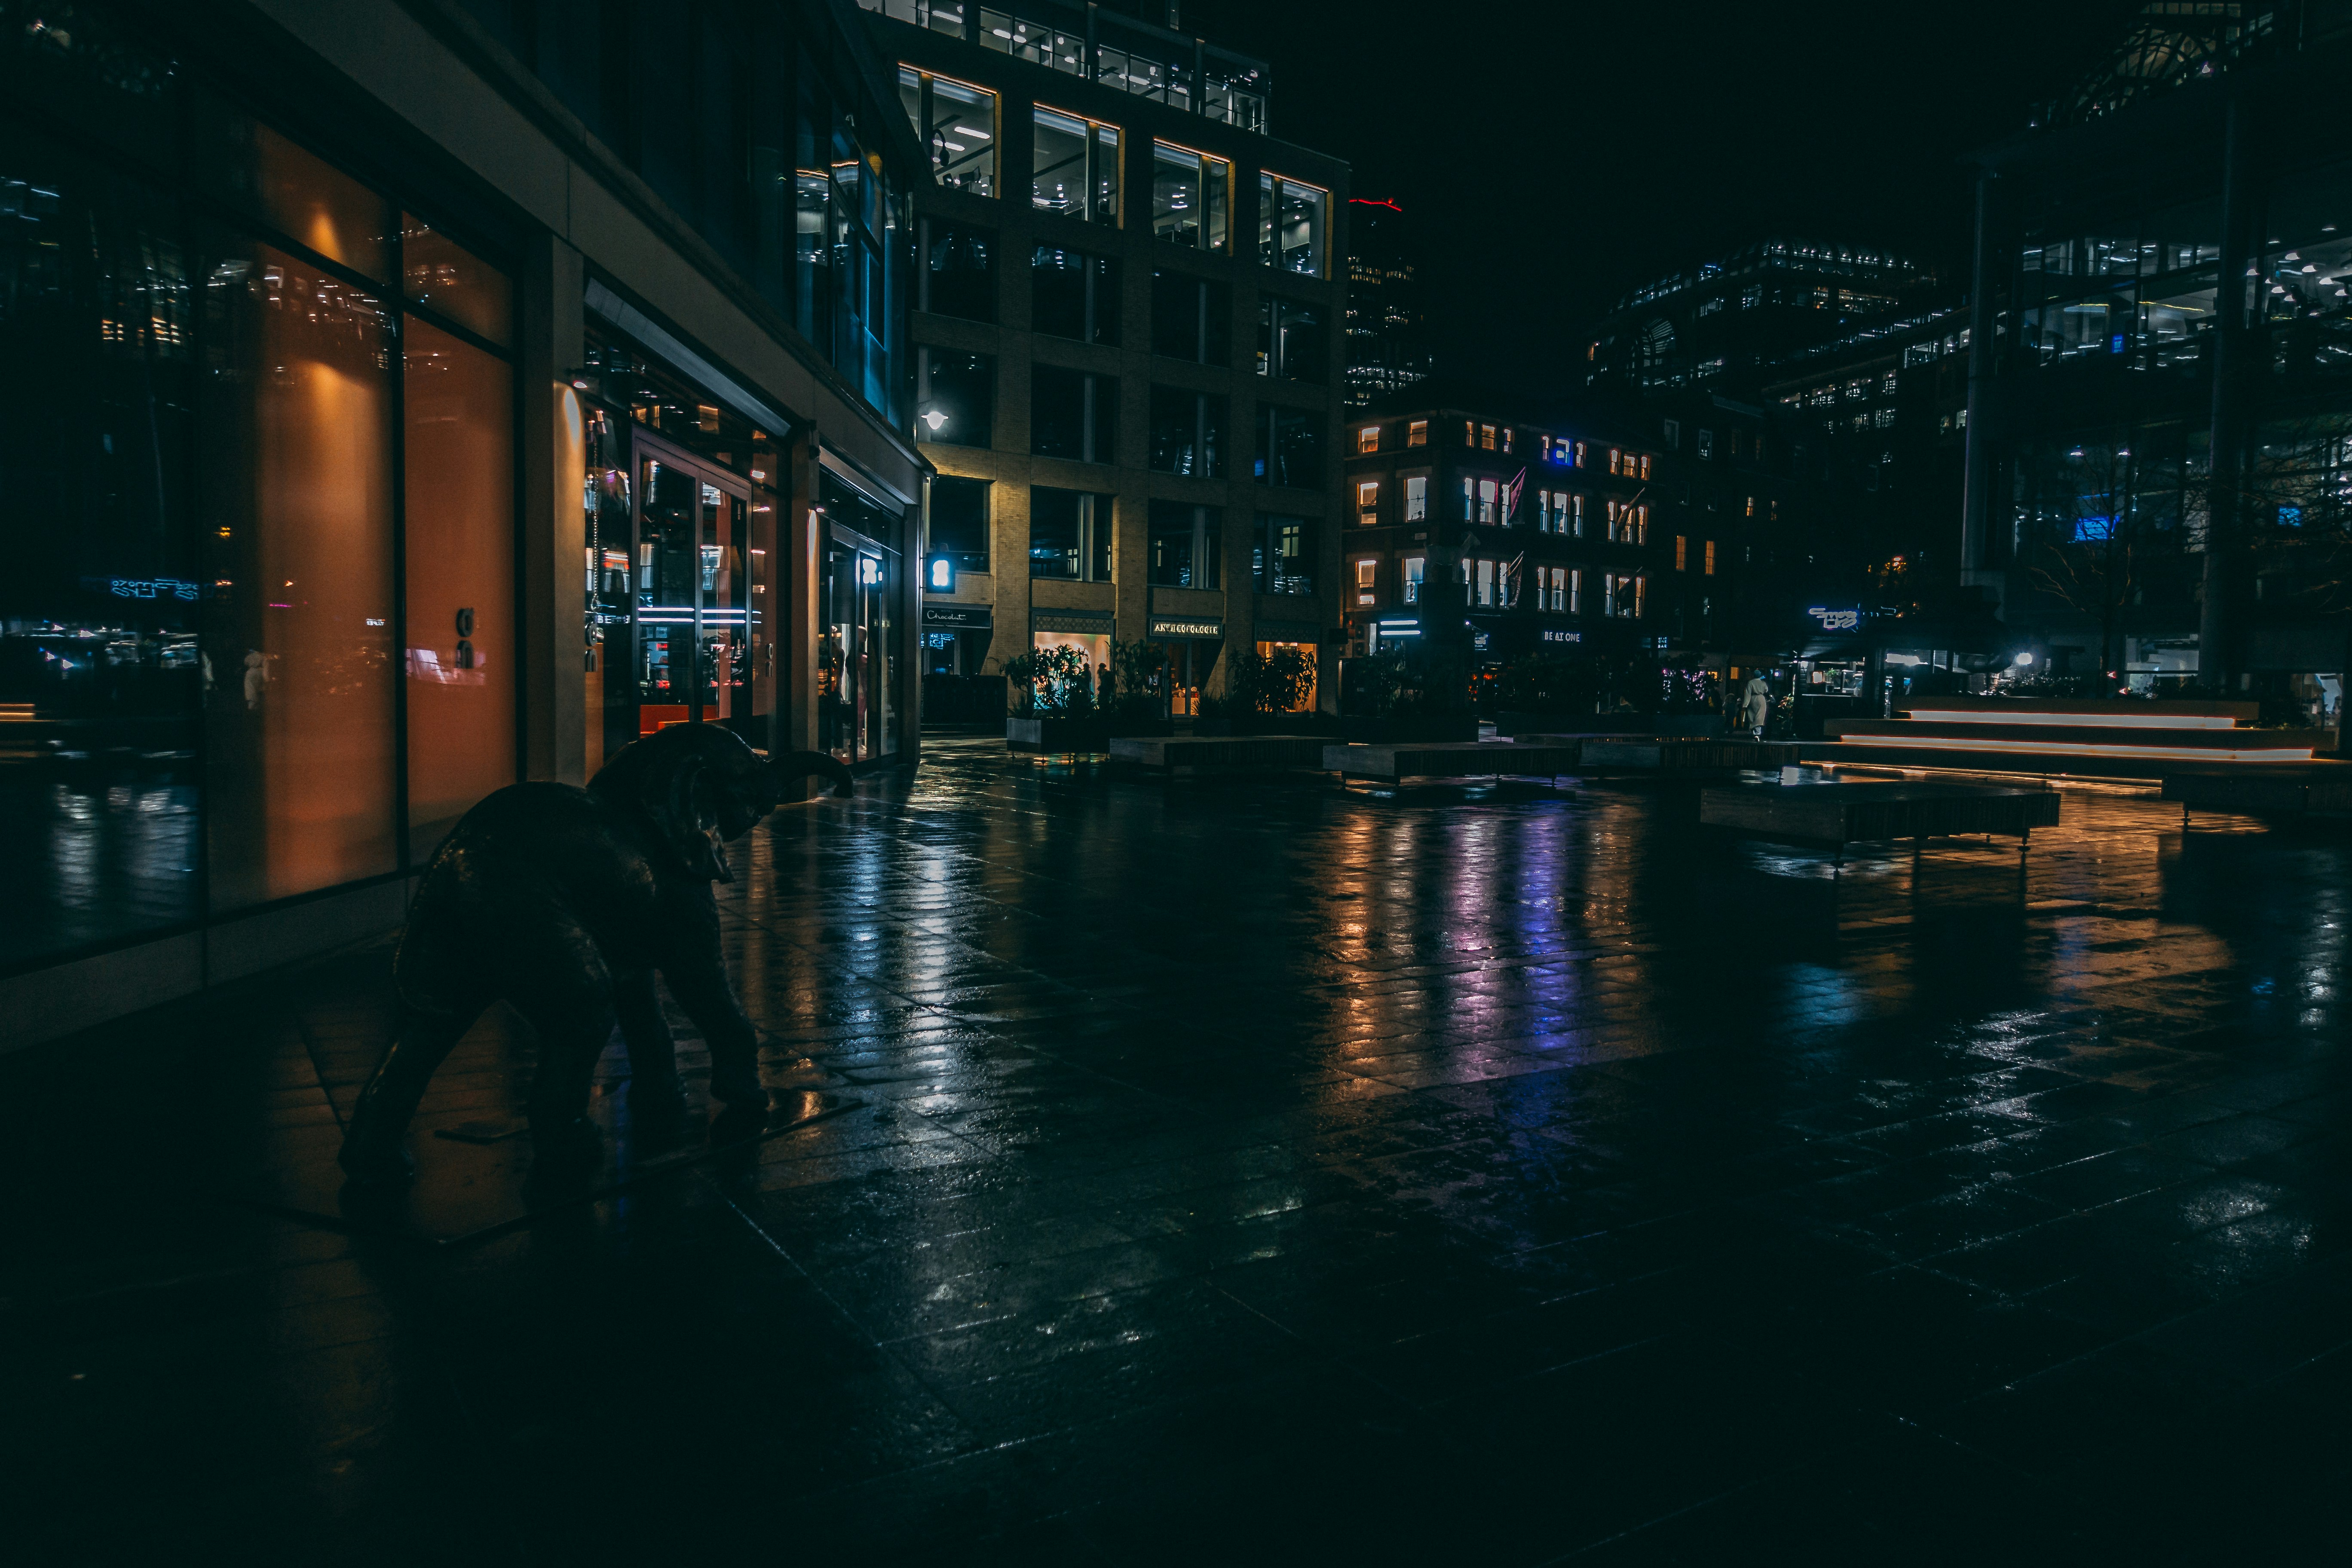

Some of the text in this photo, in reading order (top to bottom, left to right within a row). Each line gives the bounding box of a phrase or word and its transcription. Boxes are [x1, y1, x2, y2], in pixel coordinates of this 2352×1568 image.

[1155, 624, 1218, 634] ANTHROPOLOGIE
[1544, 631, 1580, 642] BE AT ONE
